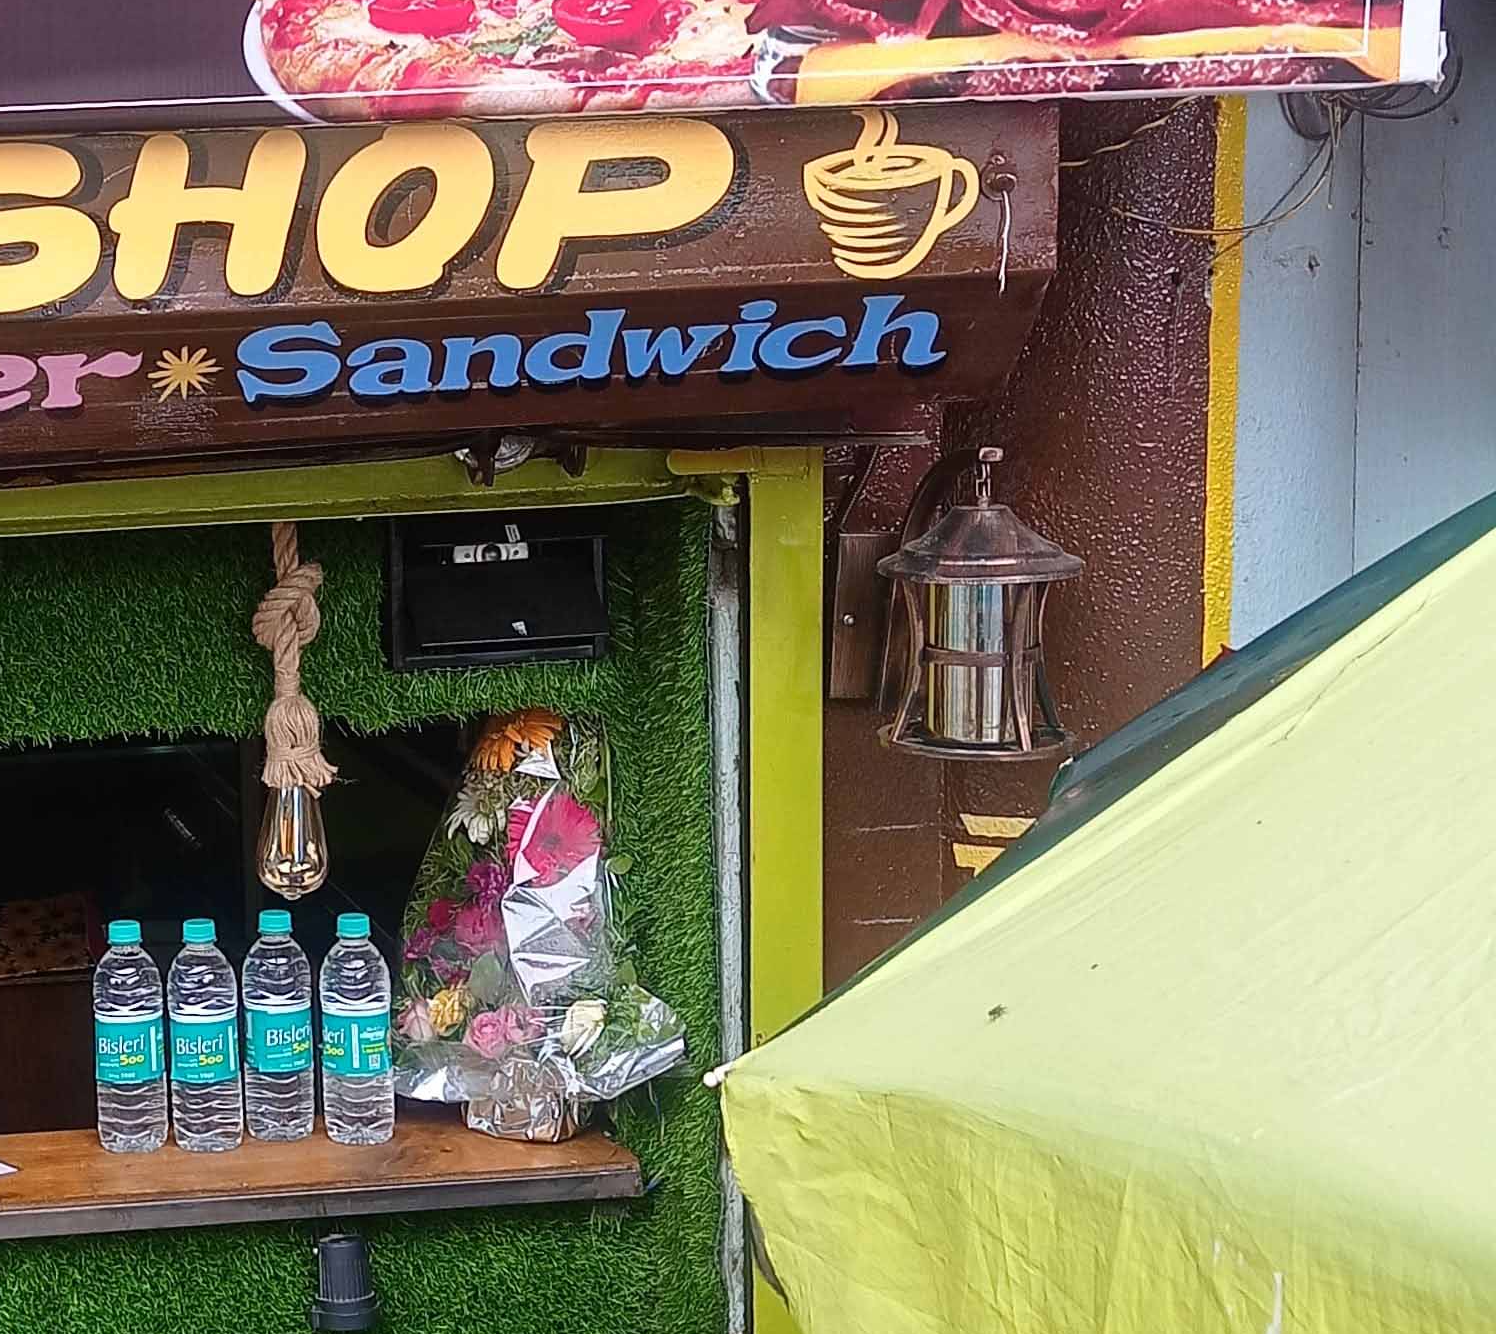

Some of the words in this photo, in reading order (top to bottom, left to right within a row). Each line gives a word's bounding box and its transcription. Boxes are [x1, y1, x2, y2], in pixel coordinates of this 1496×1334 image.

[235, 294, 948, 401] Sandwich
[98, 1033, 145, 1056] Bisleri
[176, 1033, 223, 1056] Bisleri
[119, 1054, 145, 1067] 500
[199, 1054, 224, 1067] 500
